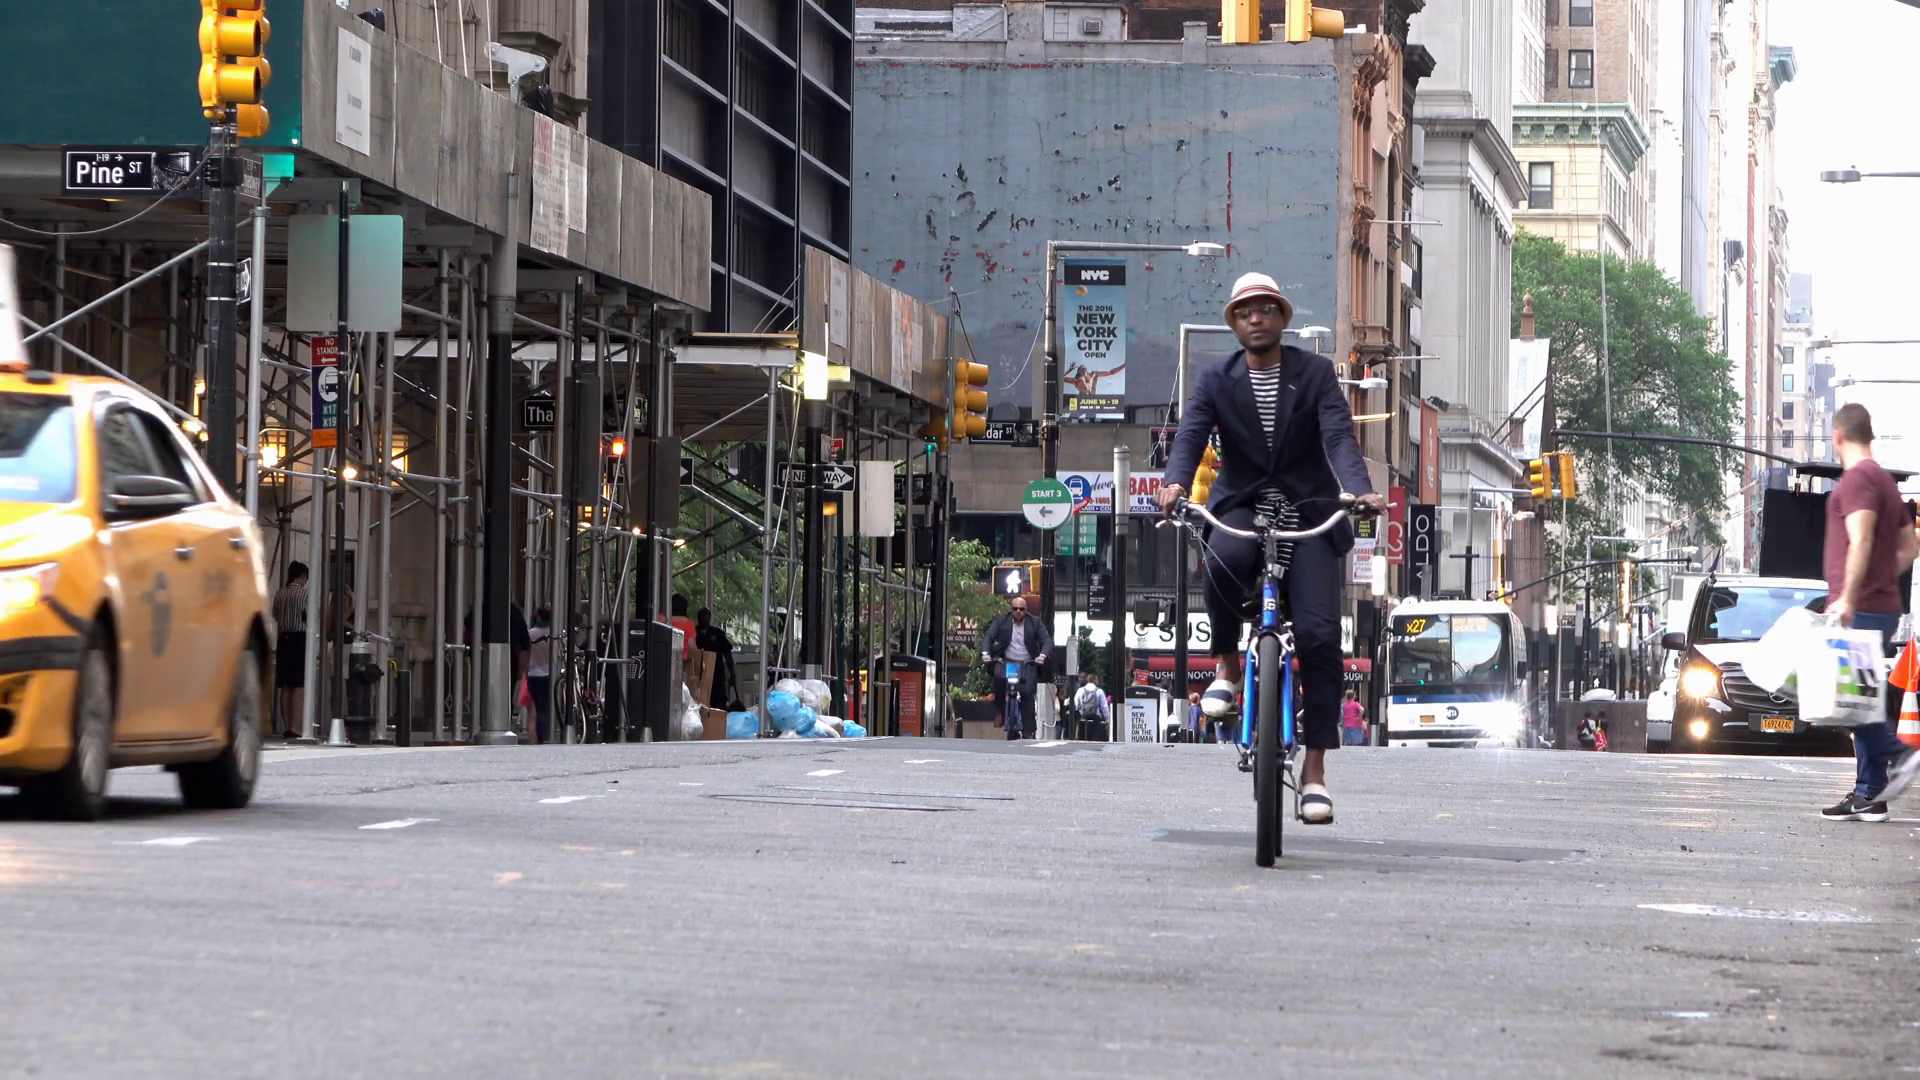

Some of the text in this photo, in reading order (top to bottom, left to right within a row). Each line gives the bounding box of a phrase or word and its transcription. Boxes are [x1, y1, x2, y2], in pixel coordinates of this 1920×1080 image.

[76, 161, 143, 184] Pine ST
[1080, 270, 1110, 281] NYC
[1076, 313, 1115, 325] NEW
[1072, 326, 1118, 338] YORK
[325, 338, 334, 346] NO
[1077, 339, 1114, 351] CITY
[1084, 351, 1106, 359] OPEN
[527, 406, 554, 423] Tha
[984, 427, 1003, 439] dar
[823, 471, 846, 483] WAY
[1031, 489, 1062, 498] START 3
[1406, 619, 1426, 633] x27
[1343, 671, 1363, 681] SUSH
